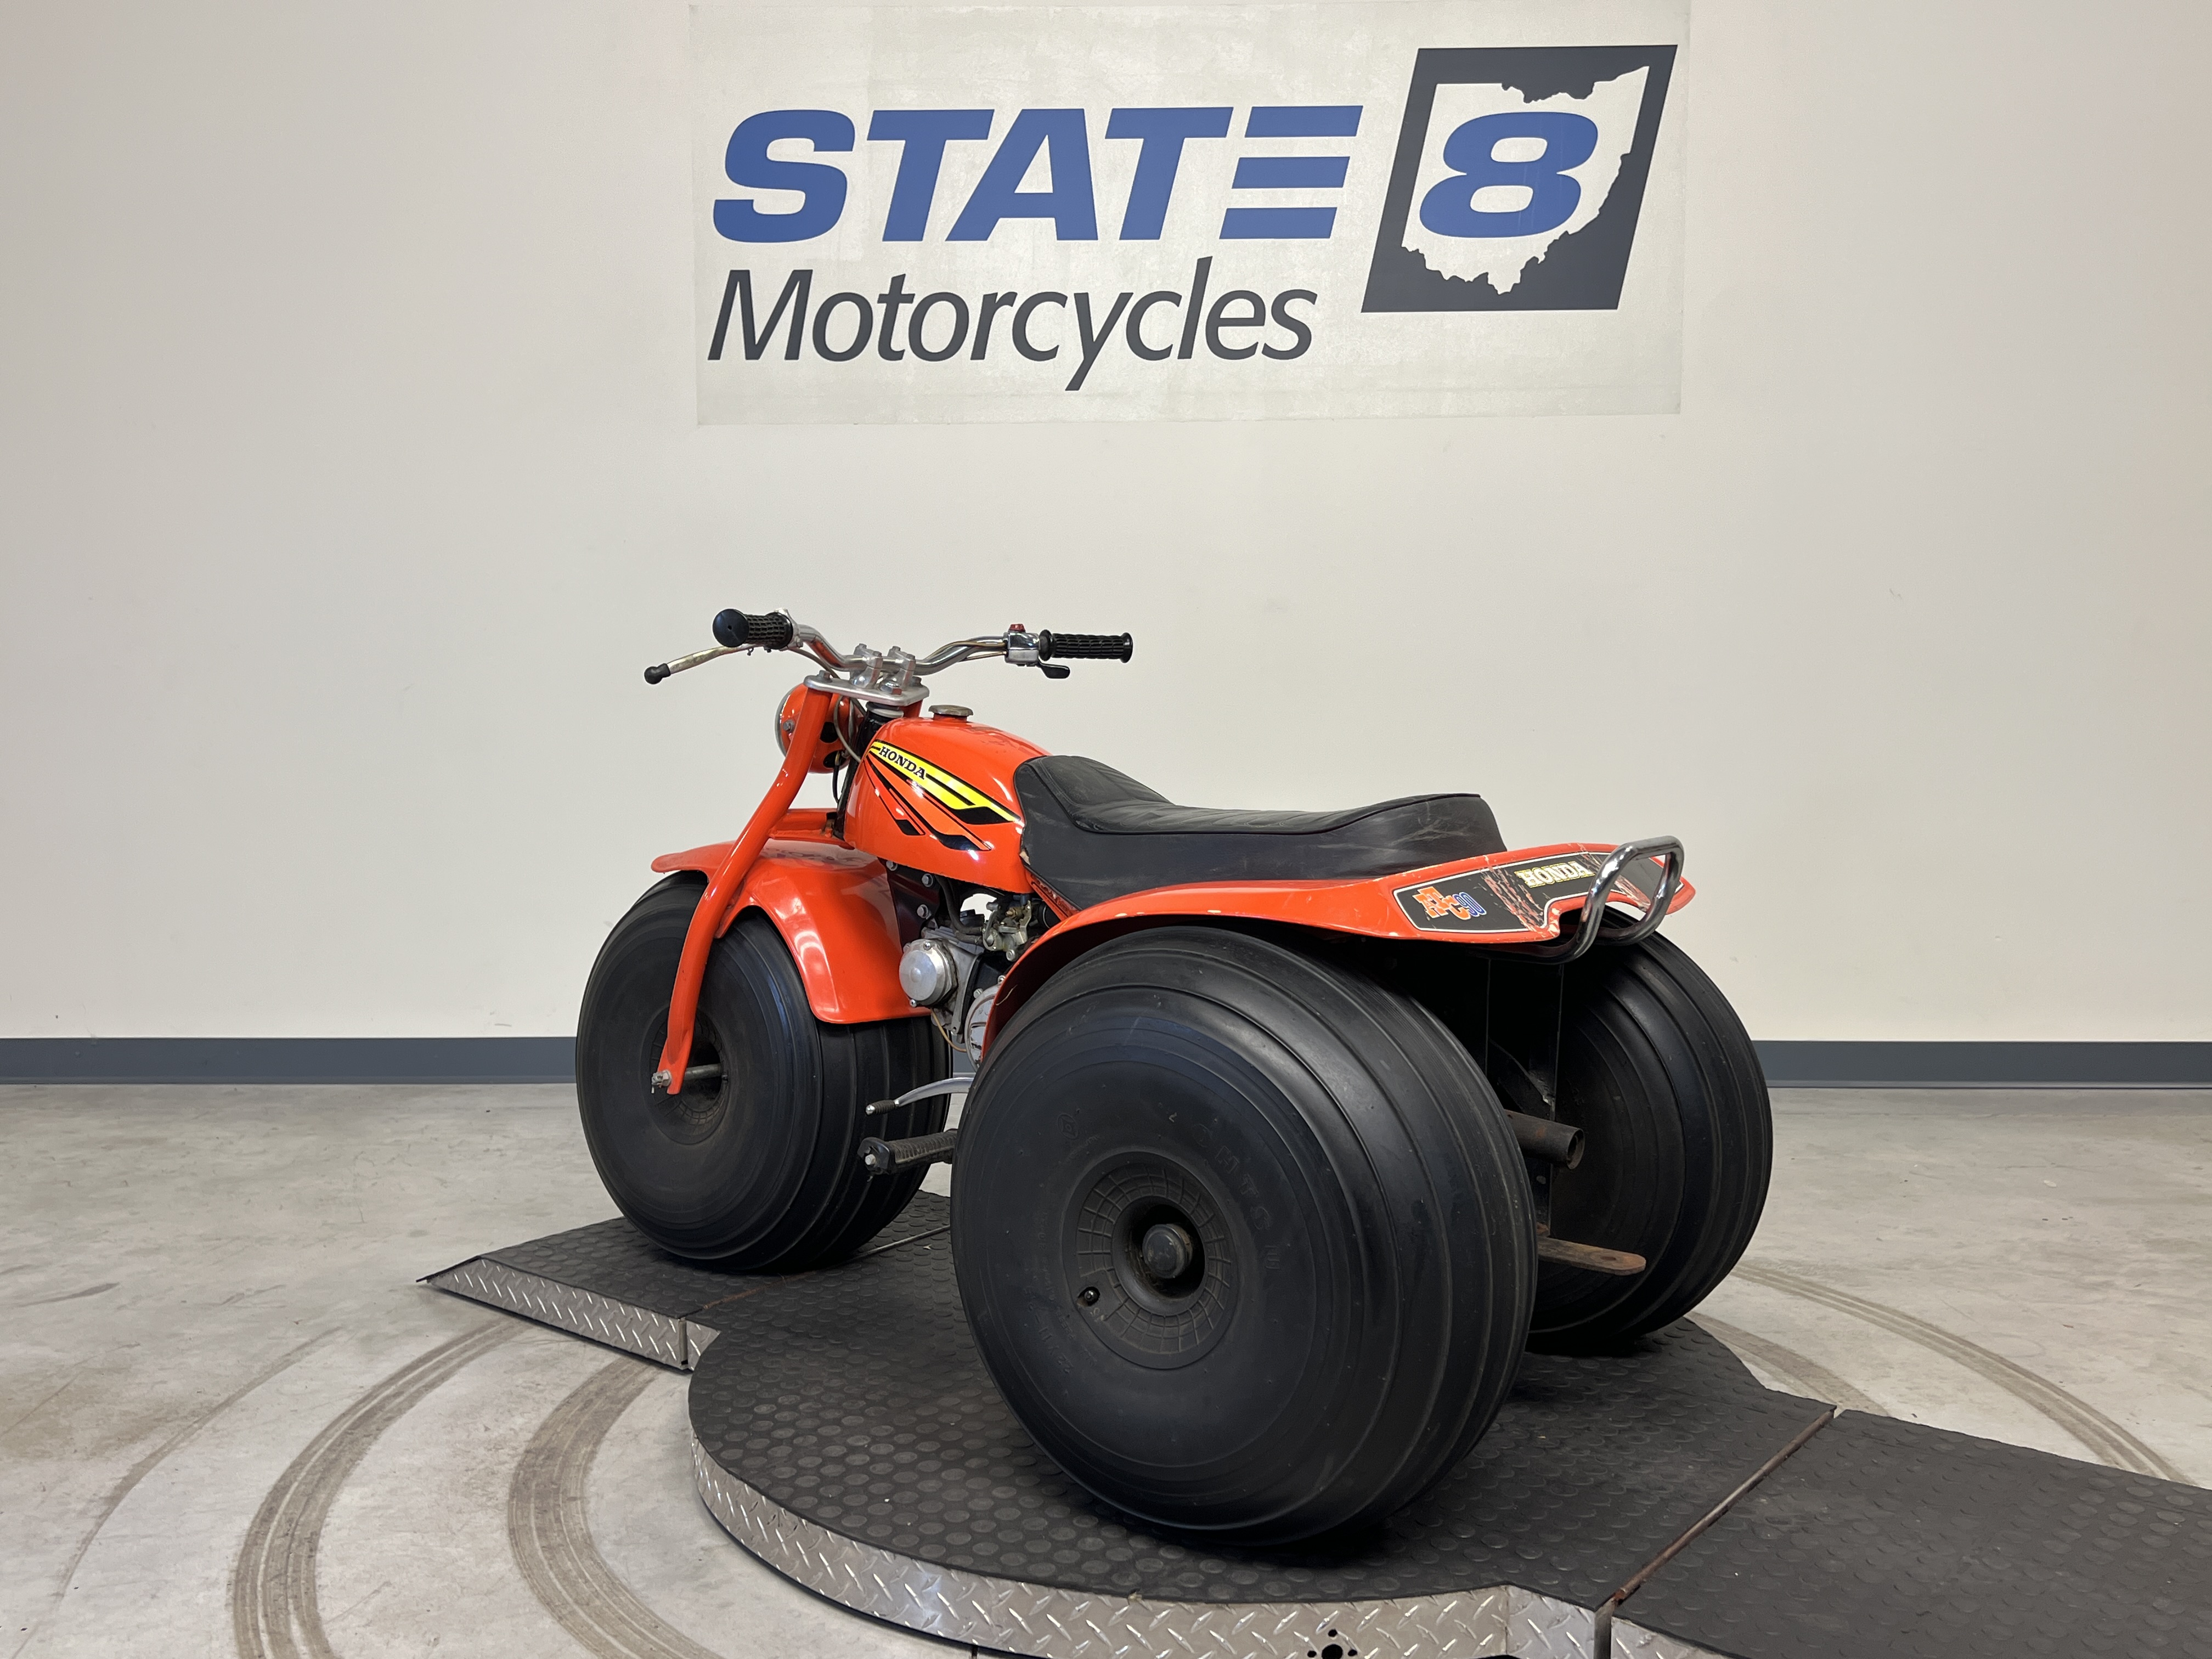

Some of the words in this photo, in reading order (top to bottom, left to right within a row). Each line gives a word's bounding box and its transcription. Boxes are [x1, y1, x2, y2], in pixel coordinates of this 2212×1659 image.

[714, 106, 1362, 242] STATE
[1420, 111, 1598, 238] 8
[707, 256, 1318, 391] Motorcycles
[878, 746, 926, 780] HONDA
[1514, 860, 1596, 888] HONDA
